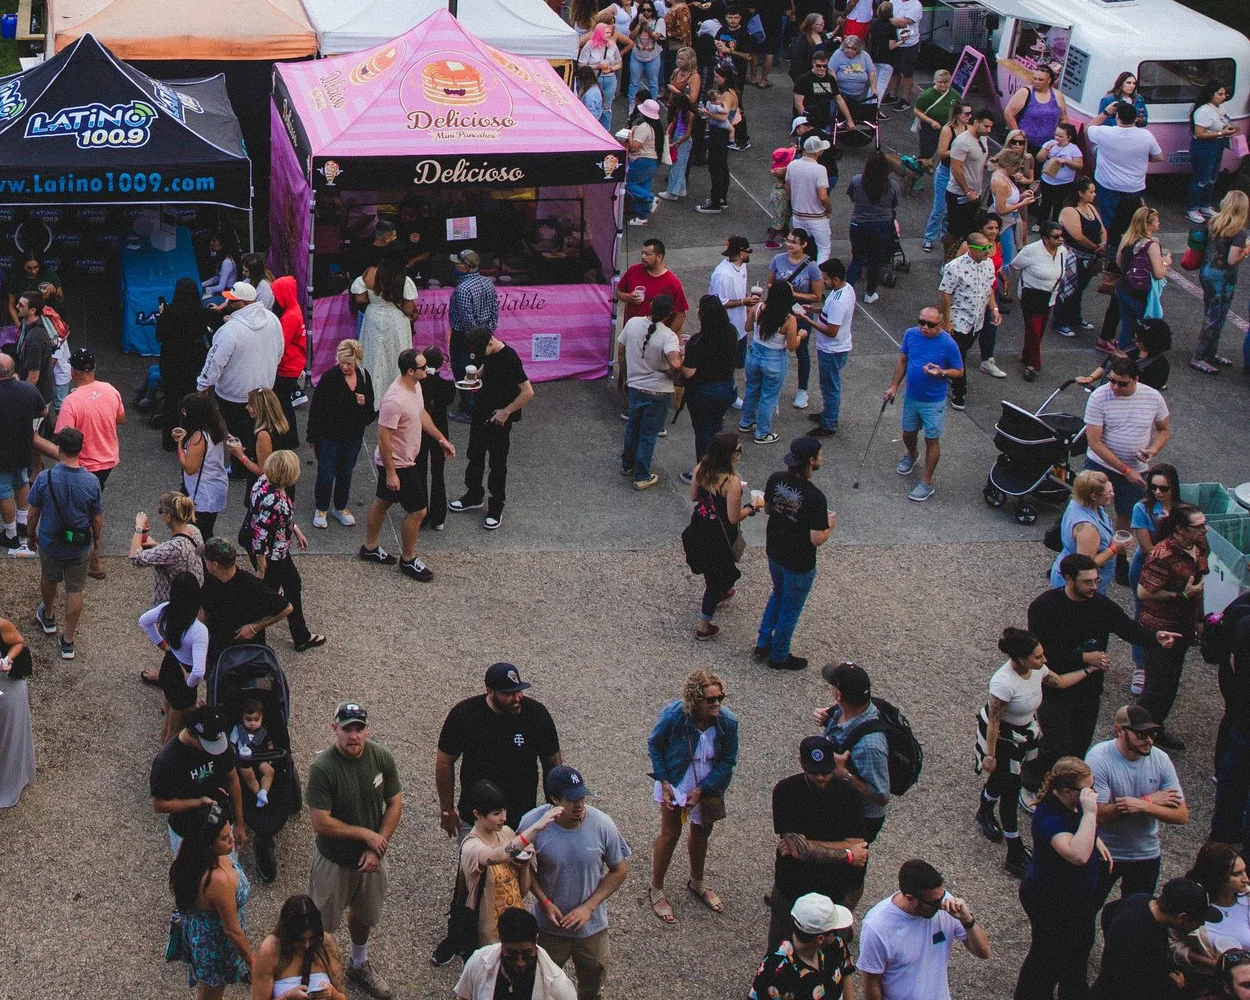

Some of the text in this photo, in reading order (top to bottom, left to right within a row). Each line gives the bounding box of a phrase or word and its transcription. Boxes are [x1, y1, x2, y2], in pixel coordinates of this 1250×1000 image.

[406, 108, 516, 130] Delicioso
[82, 129, 146, 146] 100.9
[435, 131, 455, 141] Mini
[414, 158, 525, 184] Delicioso
[498, 292, 546, 312] ilable
[190, 761, 214, 781] HUF
